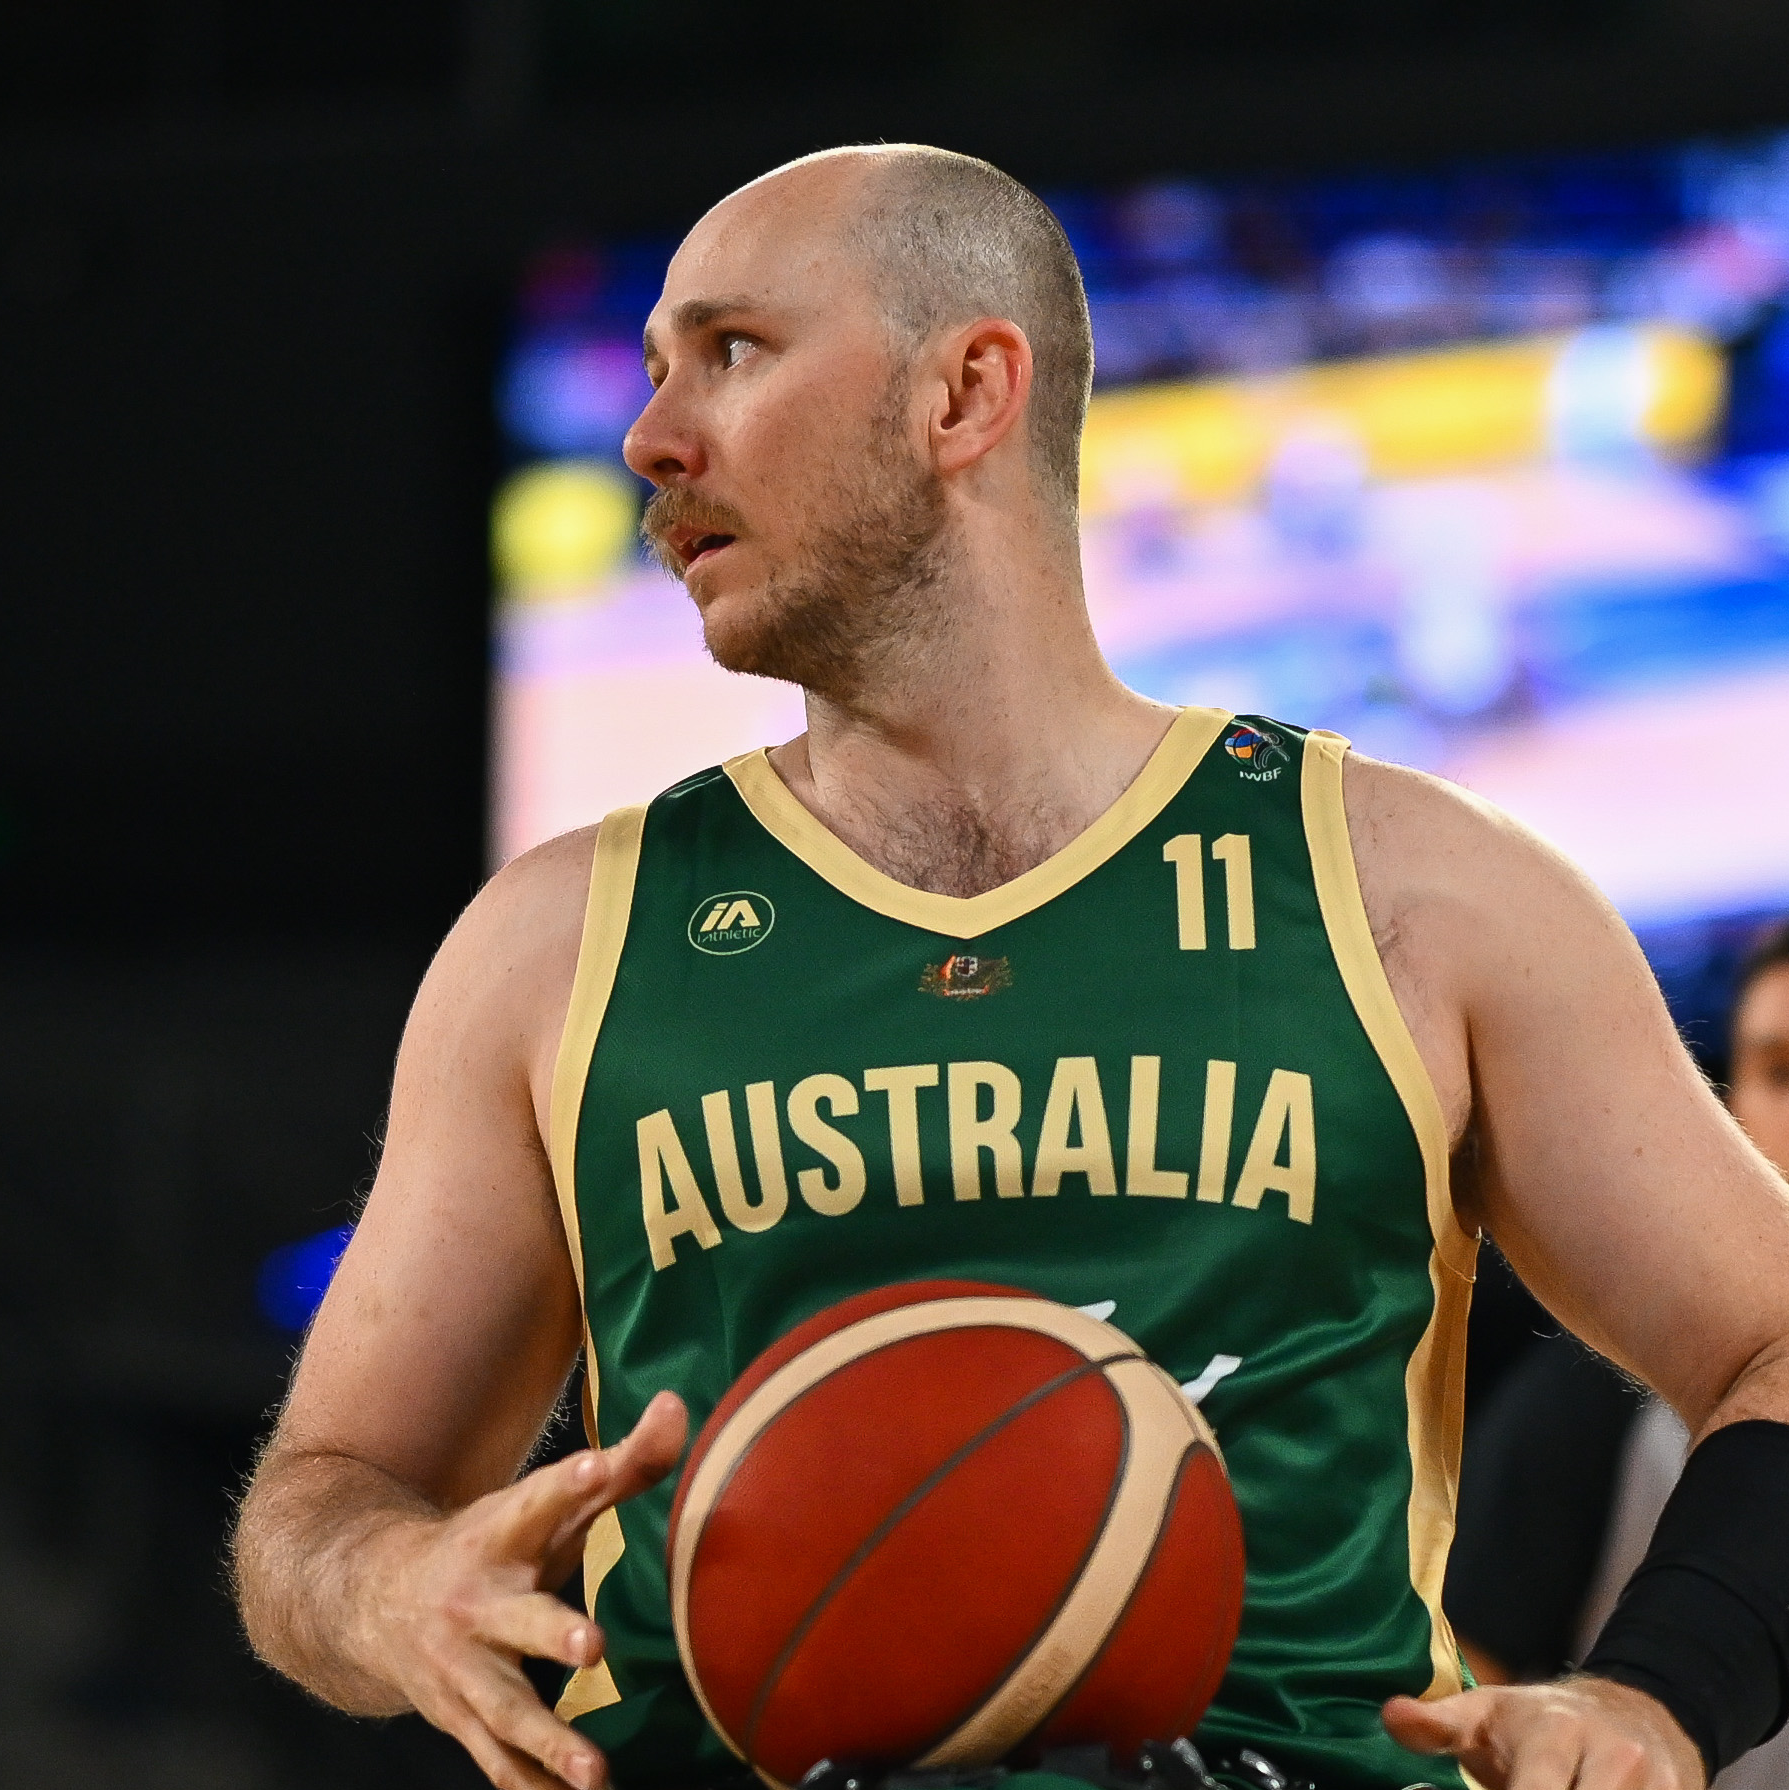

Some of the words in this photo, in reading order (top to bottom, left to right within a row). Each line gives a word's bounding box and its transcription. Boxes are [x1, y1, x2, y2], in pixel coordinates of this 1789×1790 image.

[1239, 767, 1281, 781] IWBF
[1163, 833, 1256, 950] 11
[636, 1055, 1317, 1271] AUSTRALIA
